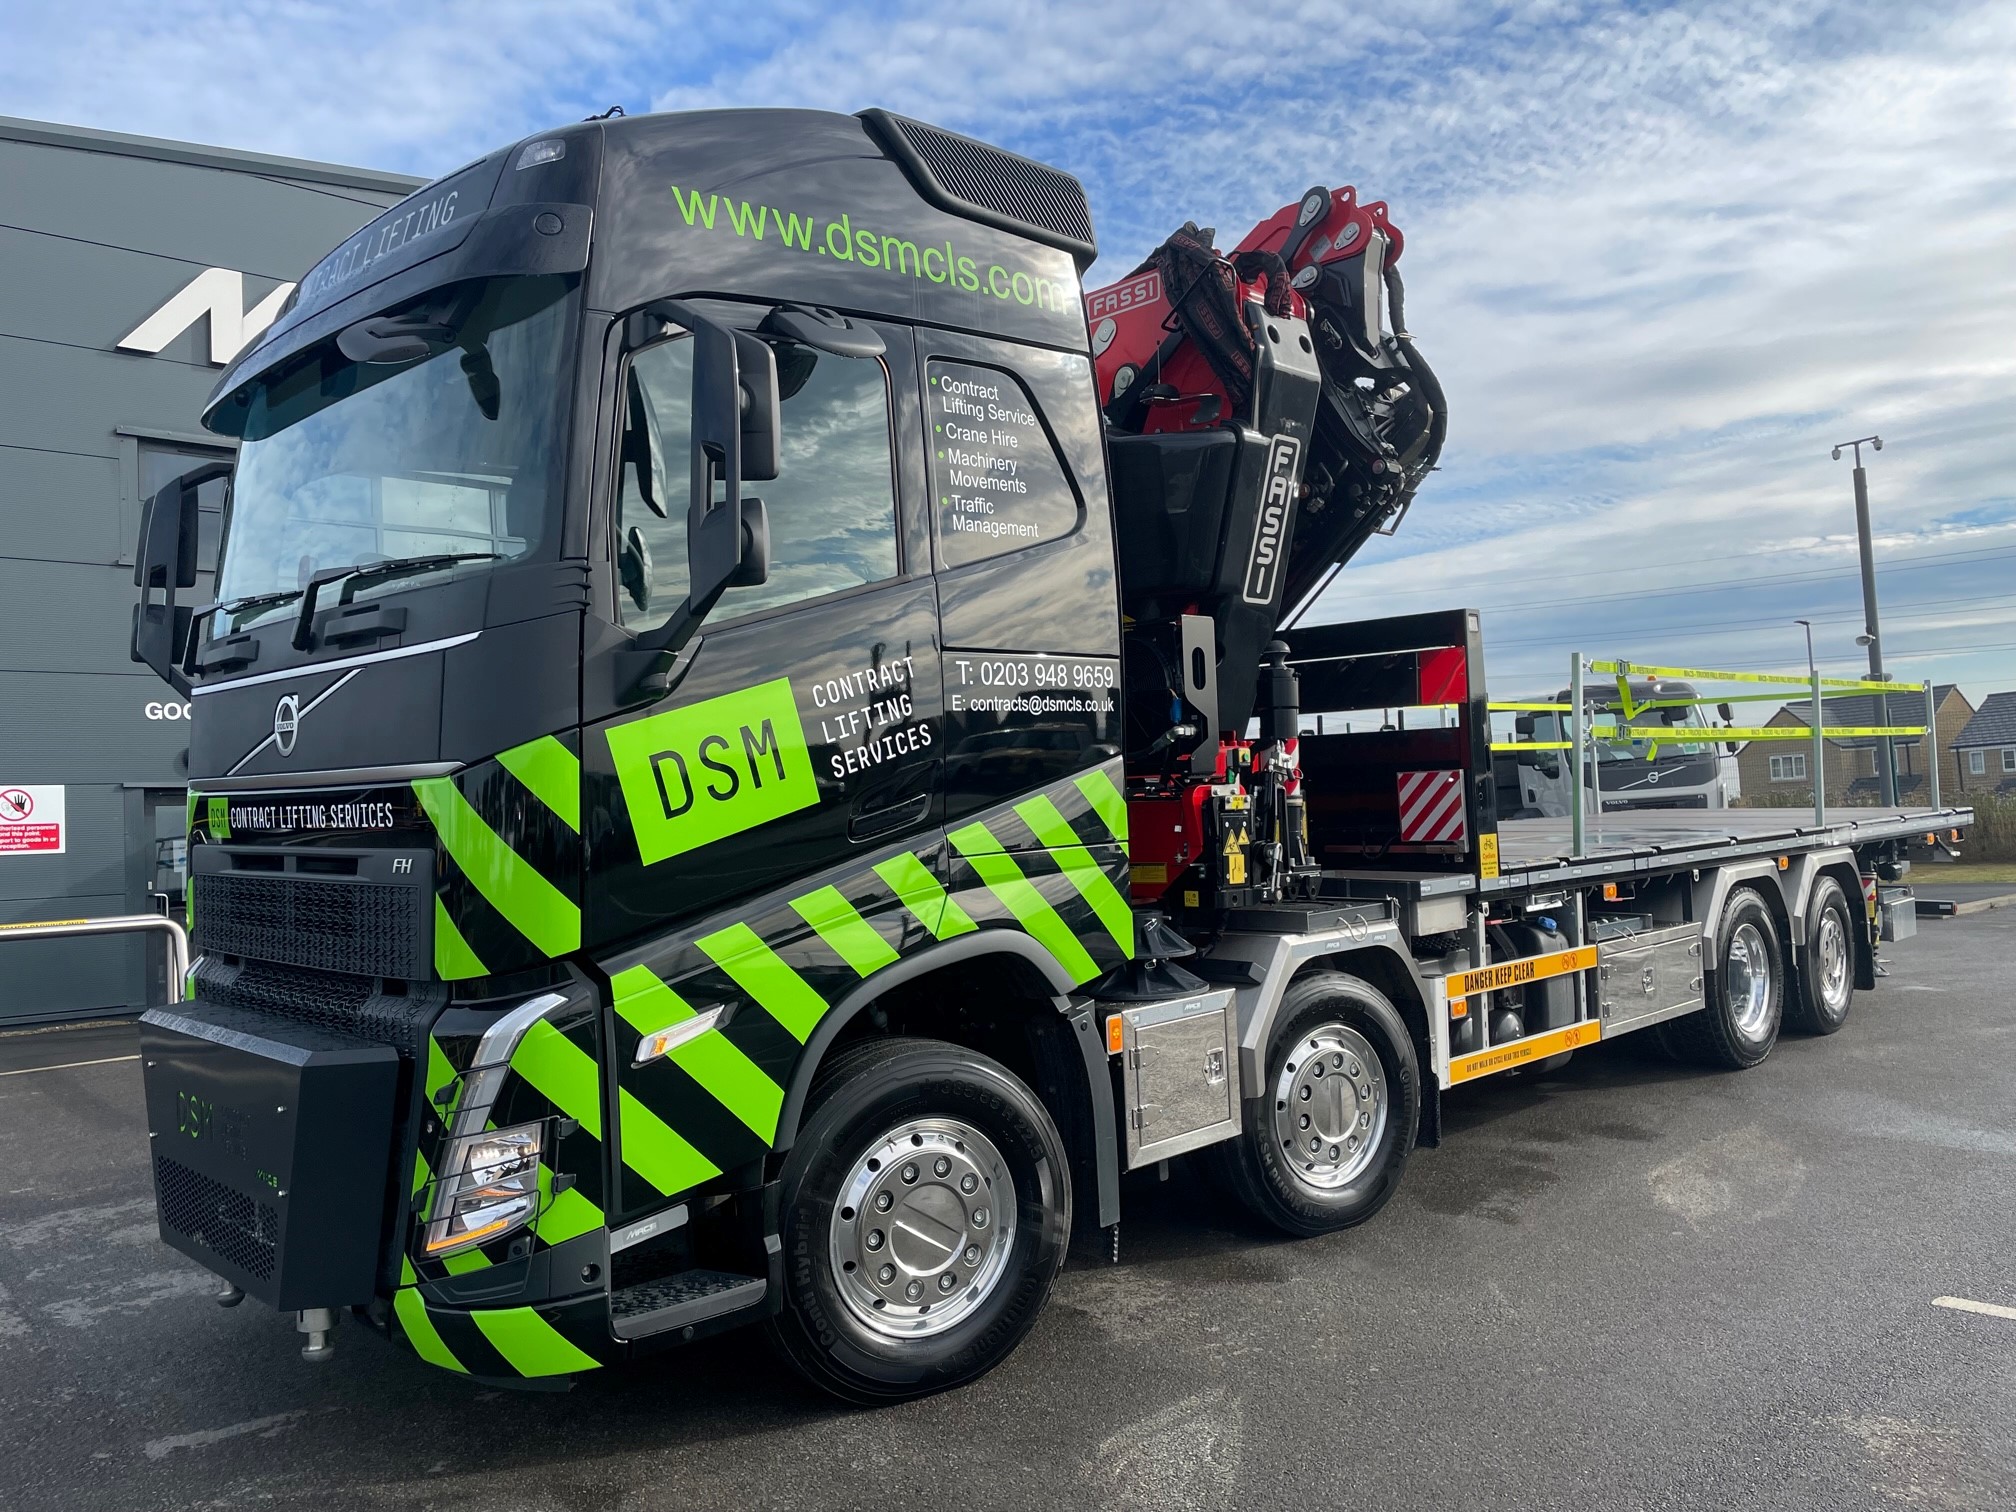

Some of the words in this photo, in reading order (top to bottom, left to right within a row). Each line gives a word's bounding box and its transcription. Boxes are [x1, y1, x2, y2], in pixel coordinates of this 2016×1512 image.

[363, 191, 459, 264] LIFTING
[671, 185, 1068, 315] www.dsmcls.com
[1094, 280, 1154, 316] FASSI
[941, 376, 999, 400] Contract
[943, 396, 984, 421] Lifting
[988, 404, 1035, 427] Service
[946, 422, 987, 443] Crane
[991, 429, 1018, 448] Hire
[948, 448, 1017, 476] Machinery
[950, 469, 1027, 494] Movements
[951, 494, 994, 515] Traffic
[953, 515, 1039, 538] Management
[1256, 445, 1294, 594] FASSI
[812, 656, 915, 708] CONTRACT
[955, 661, 974, 685] T:
[981, 661, 1029, 686] 0203
[1034, 663, 1068, 687] 948
[1073, 665, 1114, 688] 9659
[822, 694, 913, 744] LIFTING
[952, 694, 966, 711] E:
[970, 695, 1115, 715] contracts@dsmcls.co.uk
[277, 722, 294, 731] VOLVO
[830, 723, 932, 779] SERVICES
[648, 718, 786, 820] DSM
[211, 808, 226, 828] DSM
[231, 806, 276, 829] CONTRACT
[280, 804, 326, 829] LIFTING
[330, 802, 394, 828] SERVICES
[392, 859, 413, 874] FH
[1464, 970, 1493, 992] DANGER
[1495, 966, 1511, 986] KEEP
[1514, 962, 1534, 981] CLEAR
[795, 1206, 812, 1287] Hybrid
